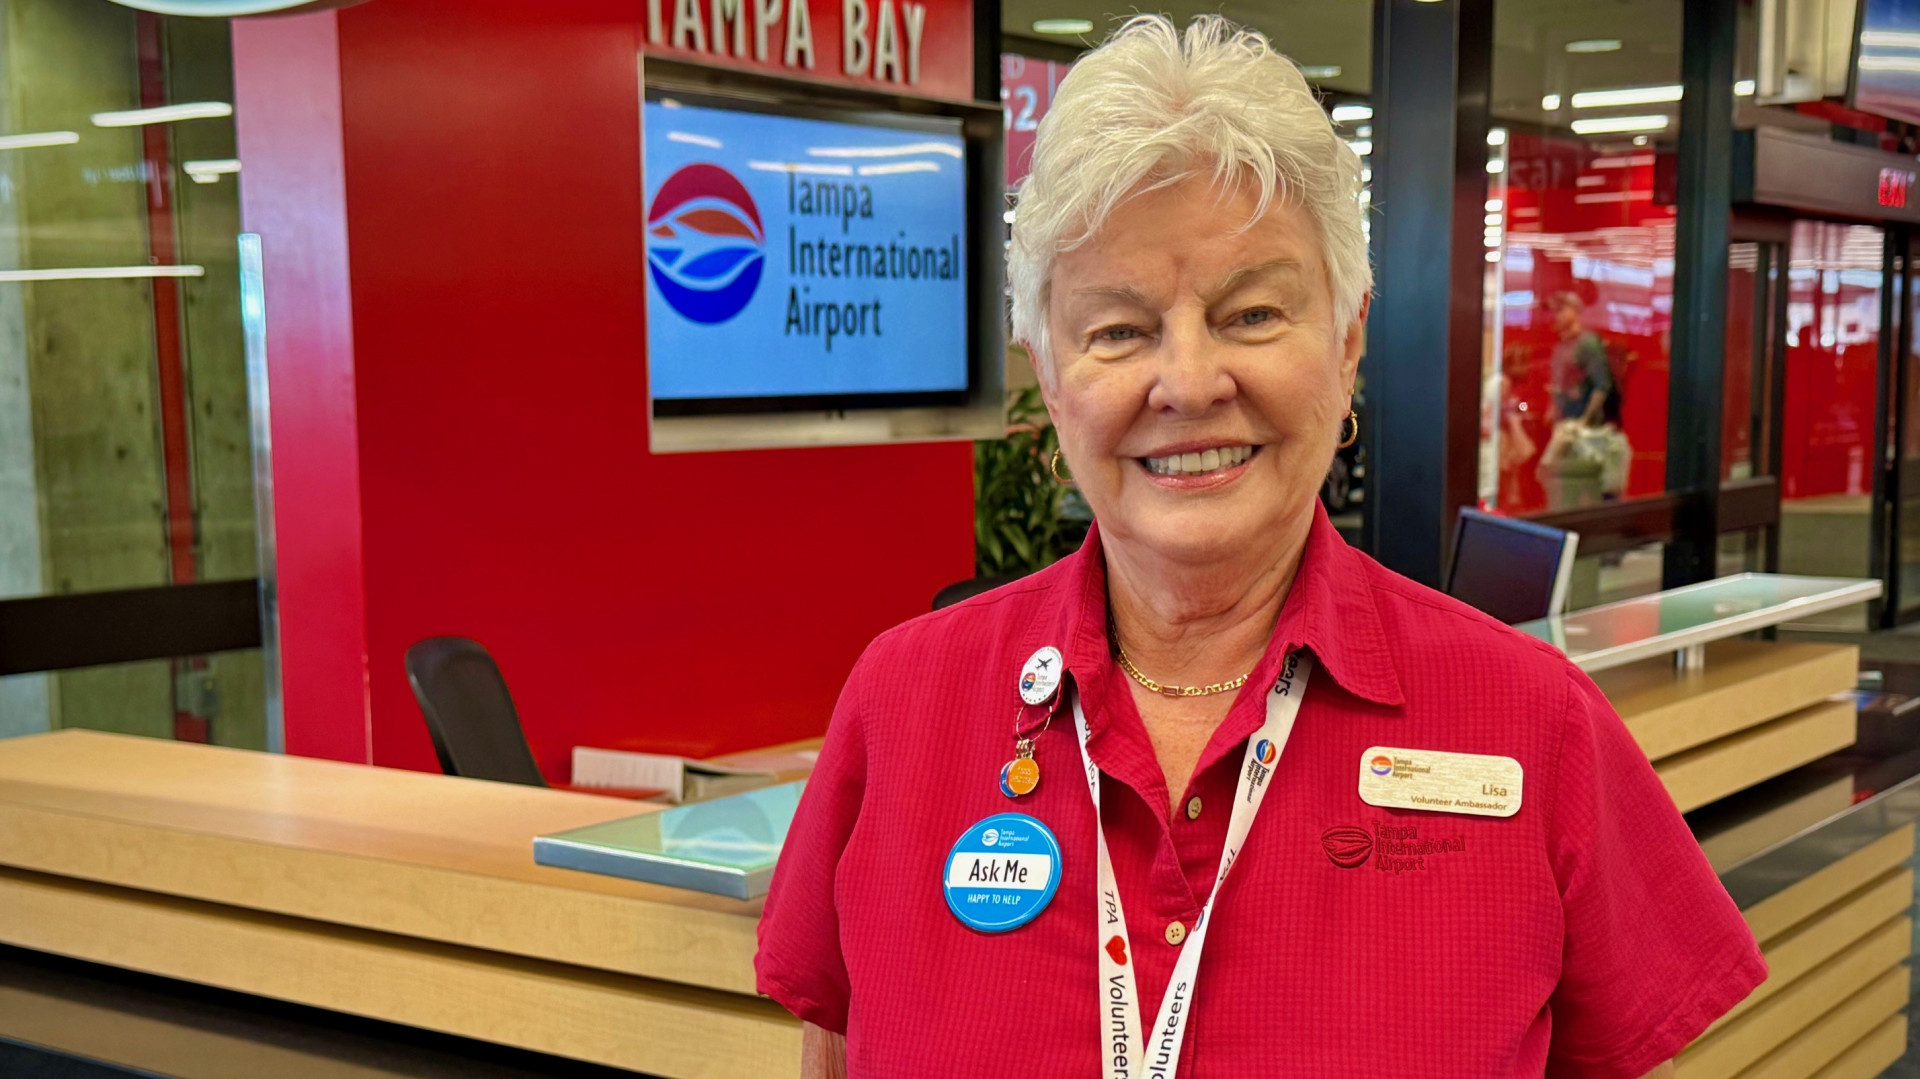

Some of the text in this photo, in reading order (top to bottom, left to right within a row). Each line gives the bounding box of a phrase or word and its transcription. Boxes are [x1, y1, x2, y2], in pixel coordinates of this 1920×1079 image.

[844, 0, 926, 86] BAY
[788, 163, 873, 235] Tampa
[788, 224, 959, 281] International
[784, 284, 882, 353] Airport
[1410, 795, 1508, 811] Volunteer Ambassador
[1482, 784, 1508, 797] Lisa
[1373, 822, 1418, 841] Tampa
[1375, 835, 1466, 856] International
[968, 858, 1028, 883] Ask Me
[1375, 854, 1425, 875] Airport
[967, 894, 1021, 905] HAPPY TO HELP
[1104, 891, 1130, 1079] TPA Volunteer
[1150, 981, 1187, 1079] olunteers
